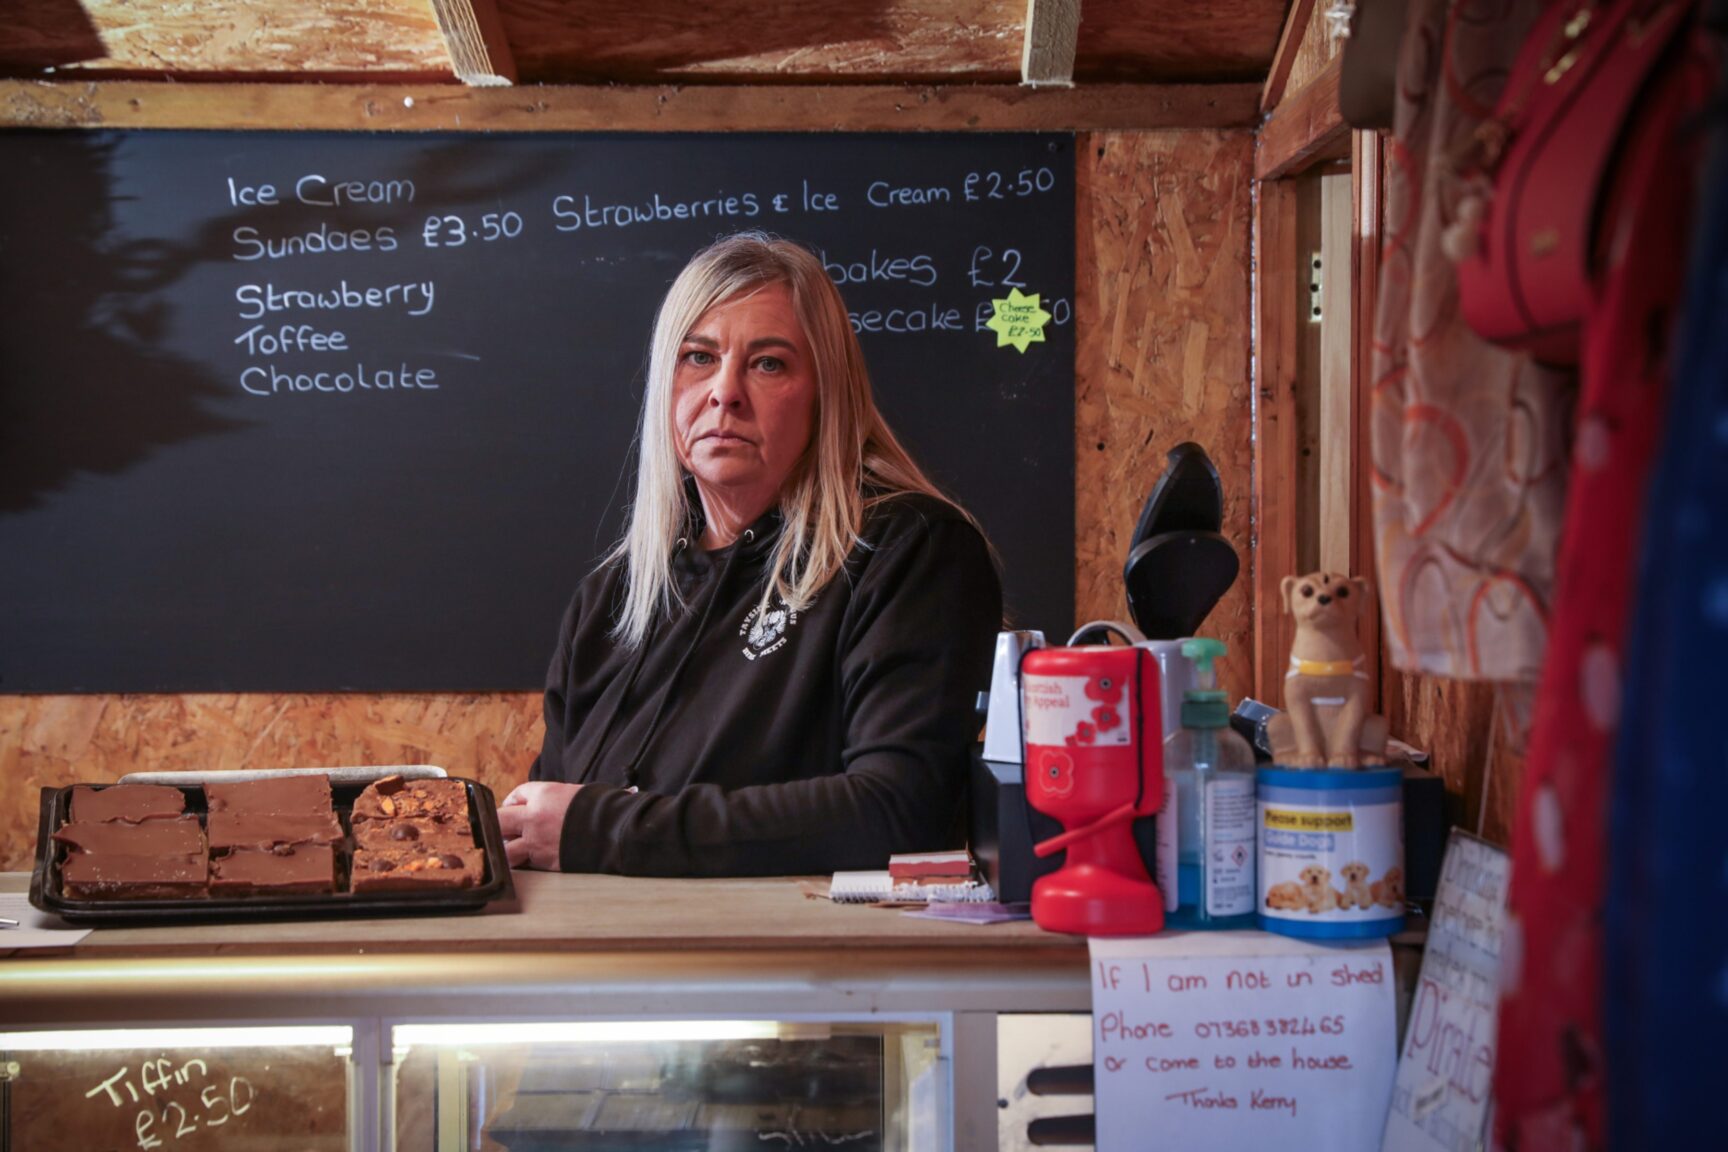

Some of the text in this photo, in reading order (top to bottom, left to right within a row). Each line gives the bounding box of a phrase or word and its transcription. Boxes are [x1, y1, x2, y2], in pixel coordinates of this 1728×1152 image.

[228, 174, 414, 206] Ice Cream
[553, 190, 760, 231] Strawberries
[804, 180, 839, 211] Ice
[867, 182, 950, 206] Cream
[964, 168, 1054, 201] £2.50
[233, 212, 522, 260] Sundaes £3.50
[822, 245, 1026, 287] bakes £2
[236, 280, 434, 319] Strawberry
[848, 303, 963, 333] secake
[234, 325, 348, 355] Toffee
[240, 364, 439, 395] Chocolate
[1100, 963, 1119, 989] If
[1143, 964, 1150, 992] I
[1168, 975, 1207, 991] am
[1227, 971, 1270, 989] not
[1101, 1011, 1172, 1041] Phone
[1146, 1058, 1198, 1071] come
[1214, 1056, 1235, 1068] to
[1248, 1052, 1281, 1068] the
[1293, 1048, 1352, 1069] house
[85, 1053, 207, 1107] Tiffin
[135, 1076, 253, 1150] £2.50
[1165, 1087, 1297, 1117] Thanks Kerry
